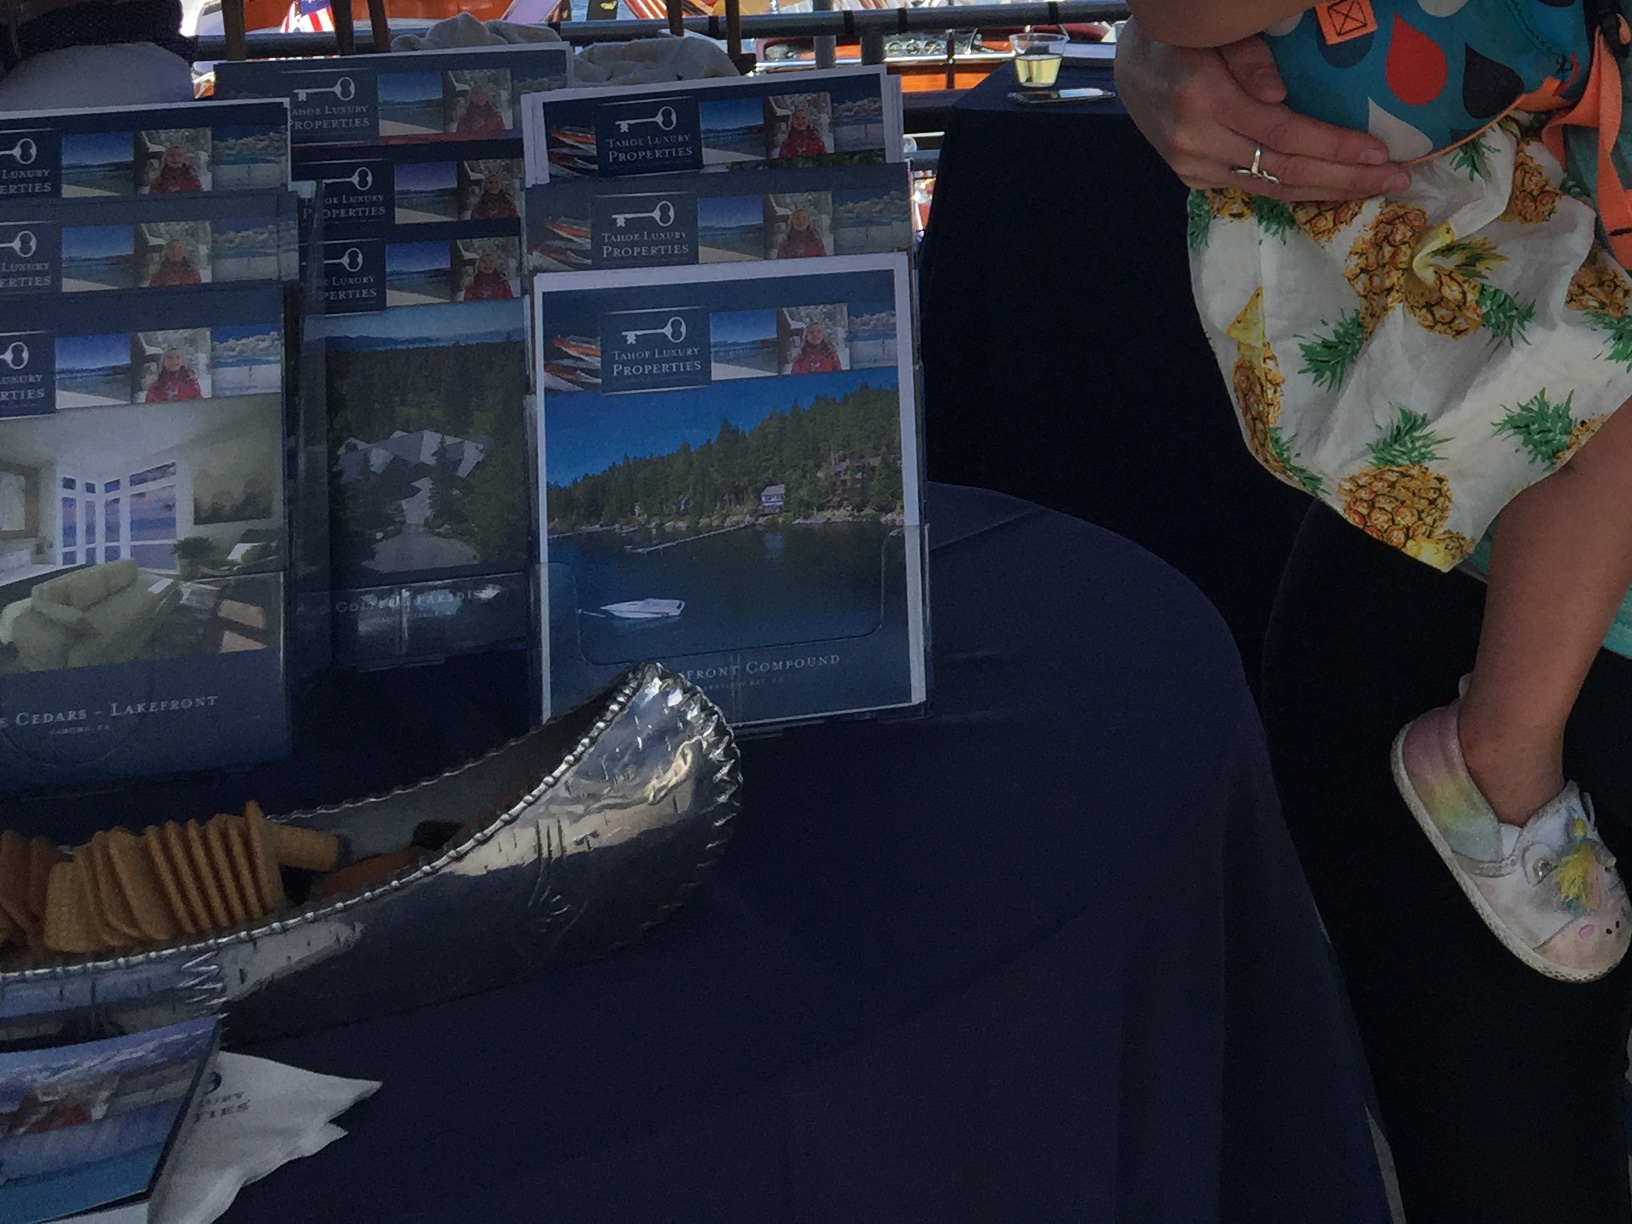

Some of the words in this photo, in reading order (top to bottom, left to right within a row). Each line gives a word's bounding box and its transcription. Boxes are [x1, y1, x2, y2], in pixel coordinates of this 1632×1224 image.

[291, 106, 322, 117] AHOE
[325, 105, 368, 116] LUXURY
[606, 136, 644, 148] TAHOE
[647, 133, 690, 146] LUXURY
[607, 145, 693, 163] PROPERTIES
[1, 168, 51, 180] LUXURY
[342, 194, 384, 205] LUXURY
[303, 206, 386, 219] POPERTIES
[602, 231, 641, 244] TAHOE
[643, 229, 688, 242] LUXURY
[602, 242, 690, 258] PROPERTIES
[1, 262, 50, 274] LUXURY
[332, 275, 376, 287] LUXURY
[612, 348, 651, 361] TAHOE
[654, 346, 700, 359] LUXURY
[612, 359, 702, 376] PROPERTIES
[746, 654, 840, 674] COMPOUND
[15, 709, 87, 726] CEDARS
[110, 695, 219, 717] LAKEFRONT
